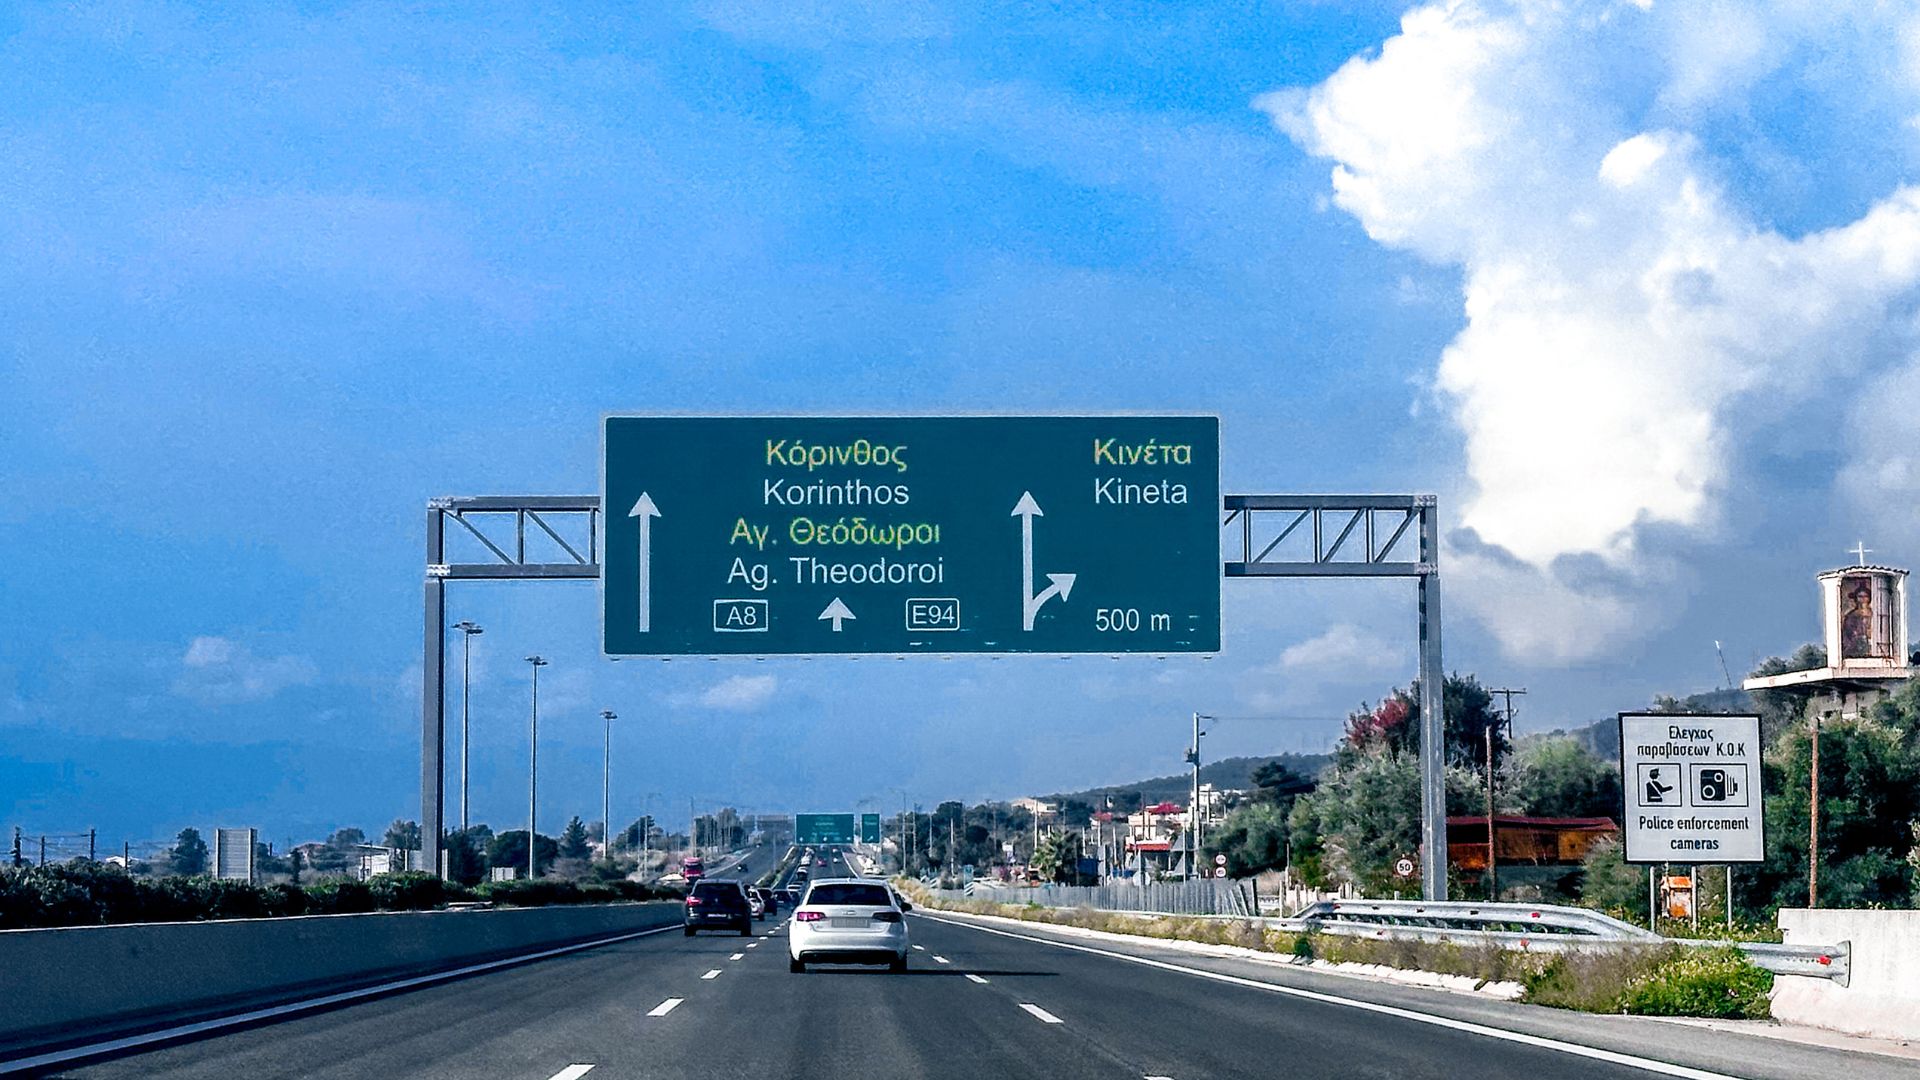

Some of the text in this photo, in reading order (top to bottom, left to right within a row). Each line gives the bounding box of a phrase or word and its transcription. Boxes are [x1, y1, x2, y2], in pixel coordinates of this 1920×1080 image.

[766, 439, 908, 472] Κόρινθος
[1094, 438, 1191, 465] Κινέτα
[763, 478, 909, 505] Korinthos
[1095, 477, 1188, 504] Kineta
[729, 516, 941, 551] Αγ. Θεόδωροι
[727, 556, 944, 591] Ag. Theodoroi
[726, 606, 757, 626] A8
[912, 604, 956, 625] E94
[1095, 608, 1171, 632] 500 m
[1637, 741, 1710, 759] παραβάσεων
[1639, 815, 1749, 830] Police enforcement
[1670, 838, 1720, 850] cameras
[1399, 863, 1411, 871] 50
